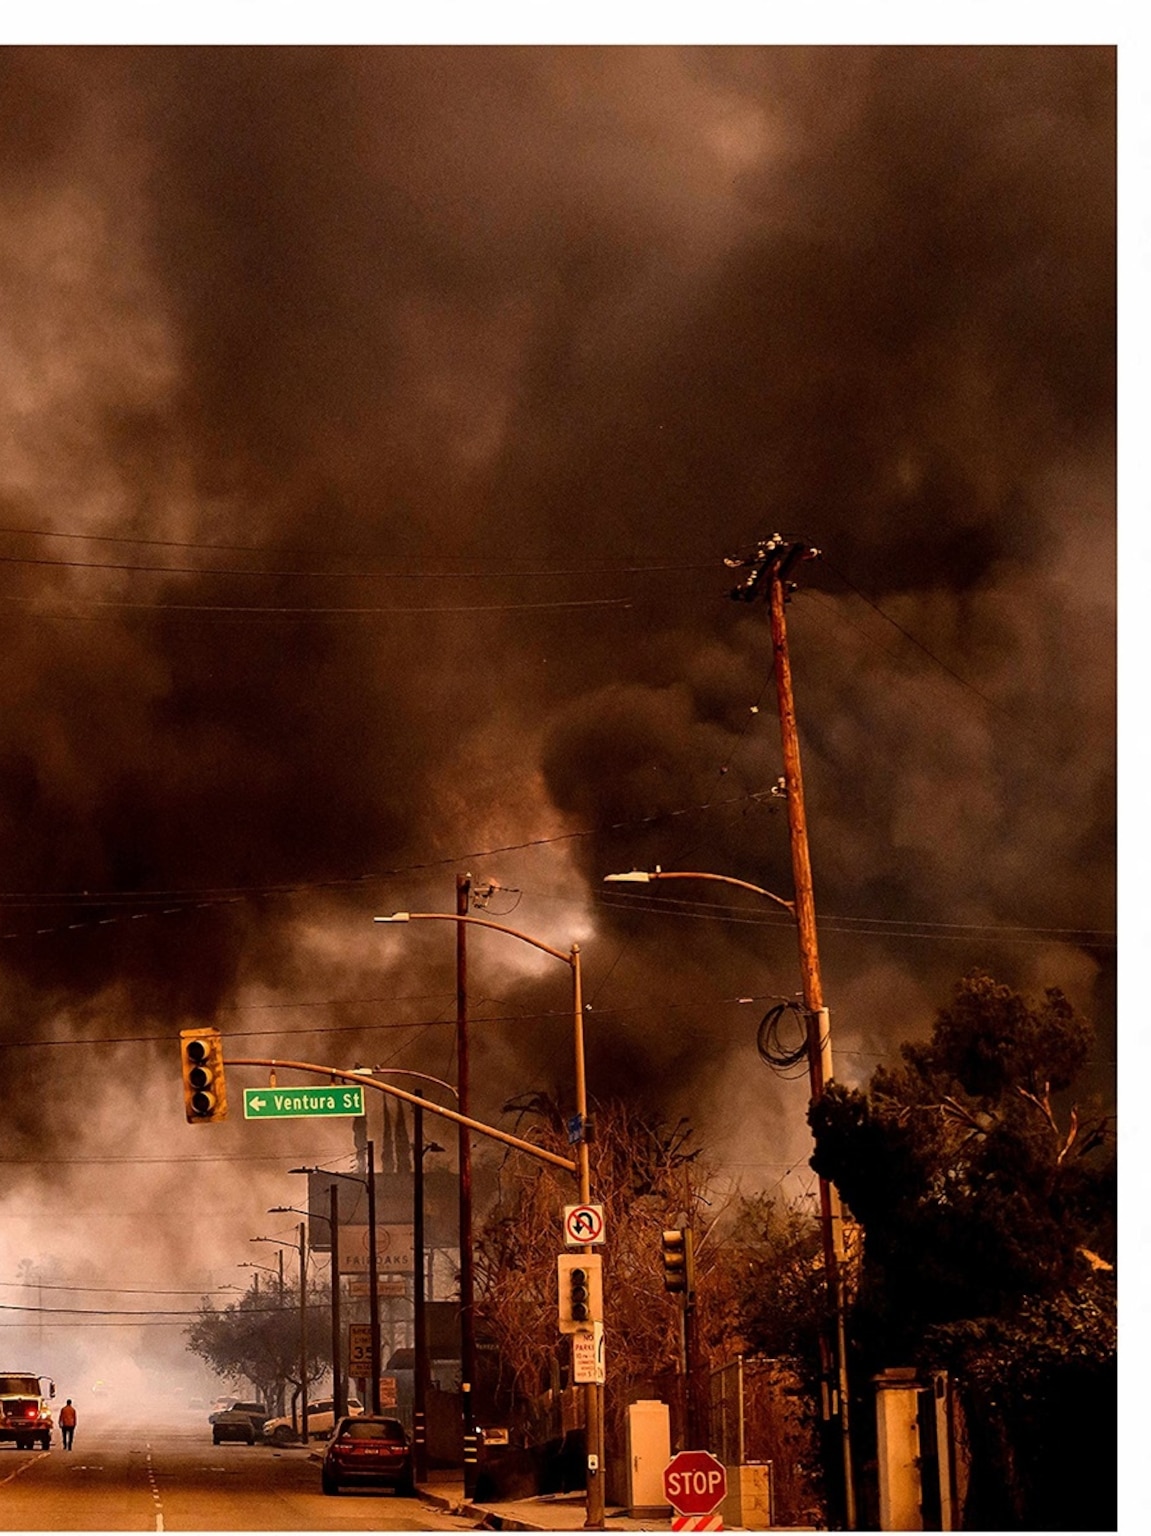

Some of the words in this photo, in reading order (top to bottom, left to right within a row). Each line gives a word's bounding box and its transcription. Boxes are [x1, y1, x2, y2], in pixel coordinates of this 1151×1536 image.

[274, 1094, 335, 1111] Ventura
[343, 1093, 360, 1109] St
[354, 1346, 372, 1359] 35
[668, 1471, 722, 1495] STOP
